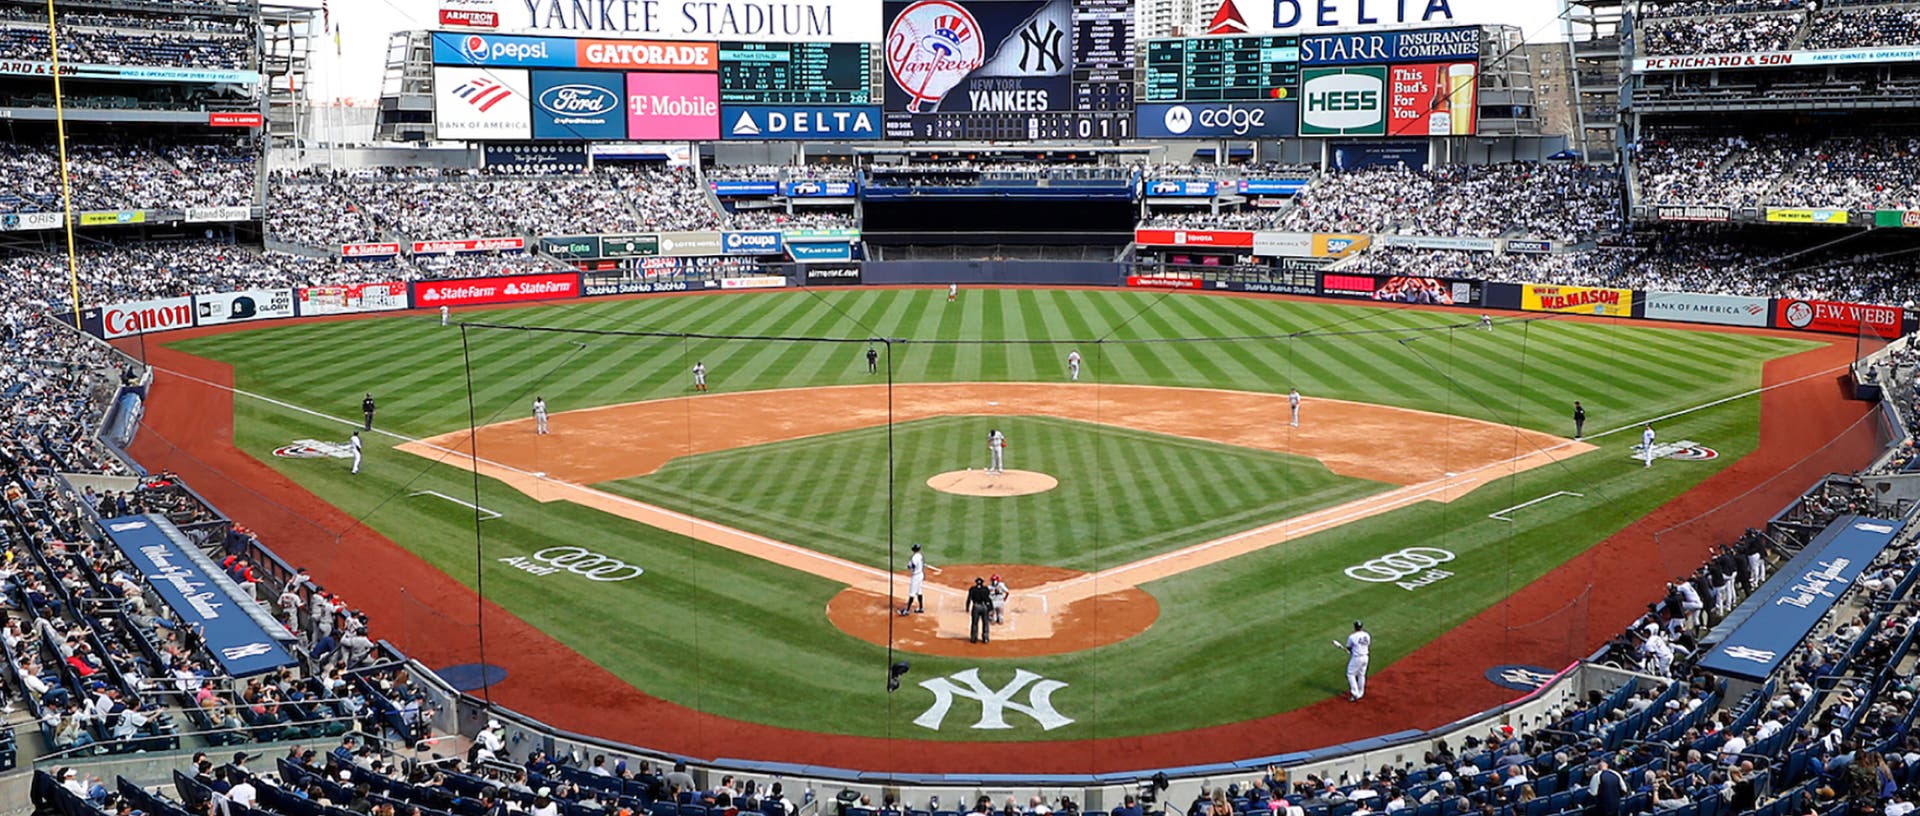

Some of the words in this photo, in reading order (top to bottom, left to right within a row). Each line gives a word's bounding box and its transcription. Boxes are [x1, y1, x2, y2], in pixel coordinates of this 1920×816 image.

[446, 11, 494, 20] ARMITRON
[525, 0, 660, 33] YANKEE
[682, 2, 832, 36] STADIUM
[1018, 19, 1065, 73] NY
[1400, 30, 1480, 46] INSURANCE
[492, 42, 548, 61] pepsi
[586, 44, 709, 65] GATORADE
[888, 33, 982, 72] Yankees
[1301, 36, 1389, 61] STARR
[1399, 43, 1480, 58] COMPANIES
[1646, 60, 1664, 68] PC
[1669, 56, 1741, 68] RICHARD
[1744, 56, 1755, 65] &
[1760, 54, 1792, 64] SON
[1394, 68, 1422, 81] This
[970, 78, 994, 90] NEW
[996, 78, 1022, 90] YORK
[1394, 81, 1428, 94] Bud's
[553, 88, 604, 111] Ford
[651, 96, 717, 116] Mobile
[969, 90, 1048, 112] YANKEES
[1309, 90, 1377, 112] HESS
[1394, 94, 1415, 106] For
[1200, 104, 1266, 134] edge
[1393, 107, 1420, 119] You.
[768, 112, 872, 133] DELTA
[1080, 120, 1090, 137] 0
[1101, 120, 1108, 137] 1
[1120, 120, 1127, 137] 1
[29, 214, 56, 224] ORIS
[219, 208, 246, 220] Spring
[1658, 208, 1683, 218] Parts
[1684, 206, 1729, 219] Authority
[570, 244, 590, 252] Eats
[741, 234, 771, 245] coupa
[440, 286, 494, 300] StateFarm
[520, 282, 571, 294] StateFarm
[586, 286, 617, 295] StubHub
[619, 284, 651, 293] StubHub
[653, 282, 686, 291] StubHub
[105, 303, 190, 332] Canon
[1693, 304, 1740, 314] AMERICA
[1815, 304, 1844, 320] F.W.
[1849, 306, 1895, 325] WEBB
[498, 556, 560, 576] Audi
[1396, 568, 1454, 591] Audi
[912, 668, 1076, 731] NY
